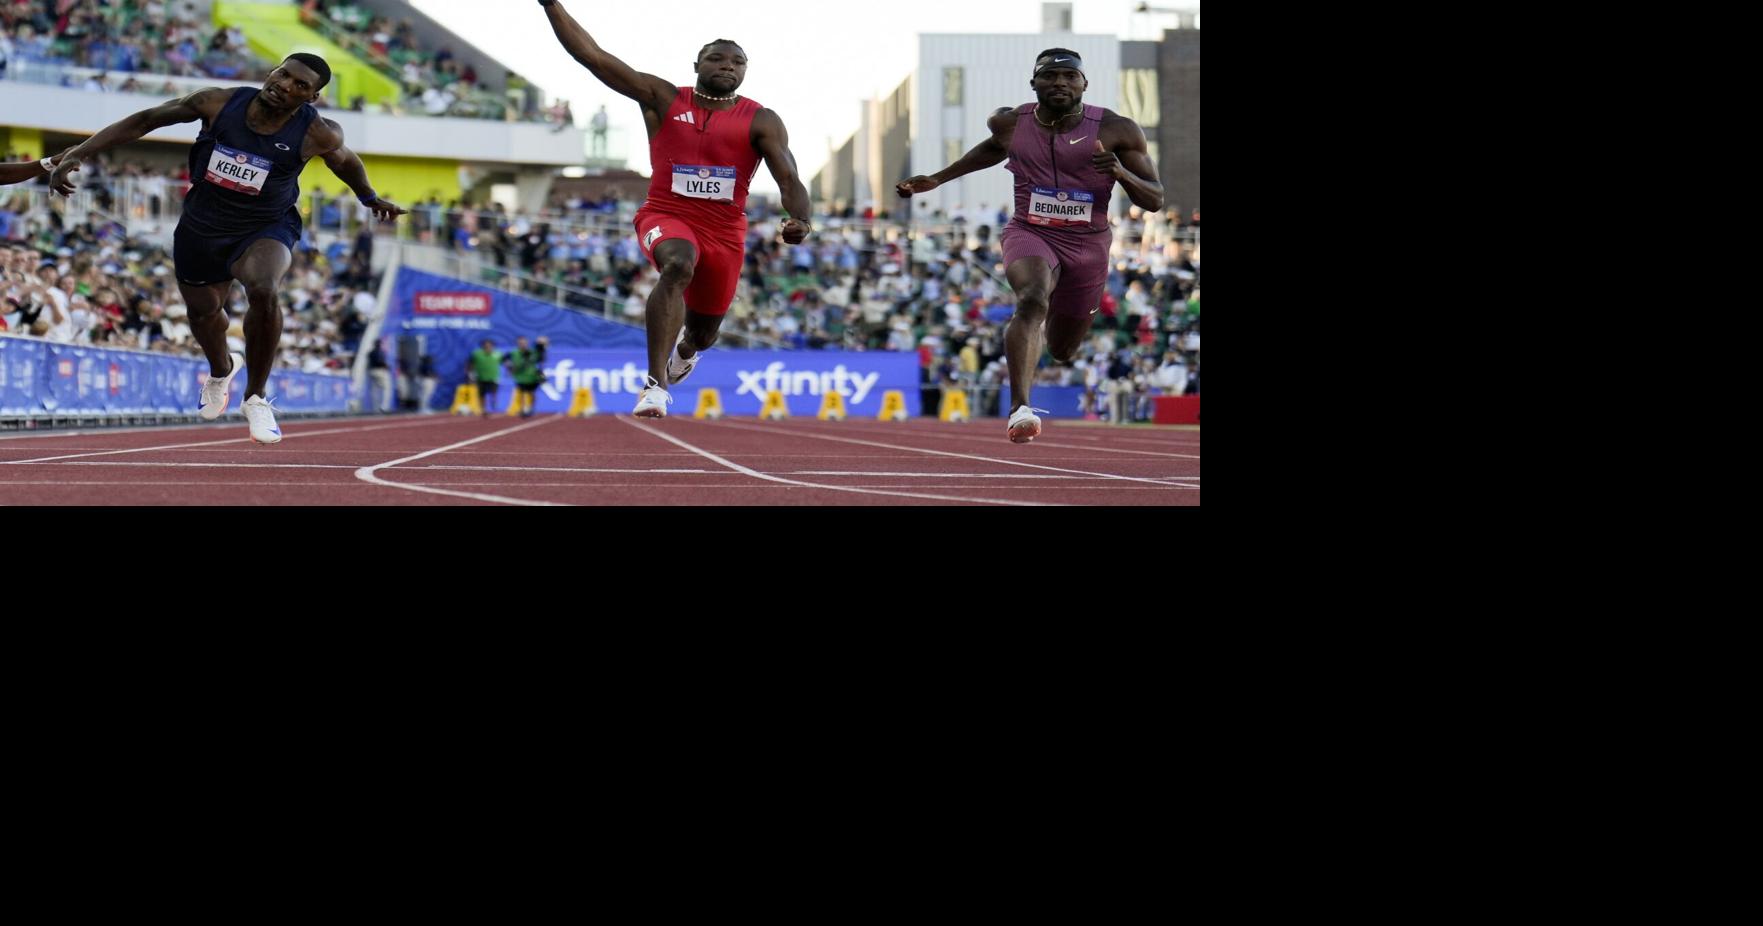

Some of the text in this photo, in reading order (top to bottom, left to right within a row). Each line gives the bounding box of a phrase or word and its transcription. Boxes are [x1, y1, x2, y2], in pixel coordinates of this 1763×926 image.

[215, 159, 258, 182] KERLEY
[686, 180, 721, 194] LYLES
[1034, 202, 1086, 216] BEDNAREK
[541, 358, 649, 401] finit
[736, 361, 880, 404] xfinity
